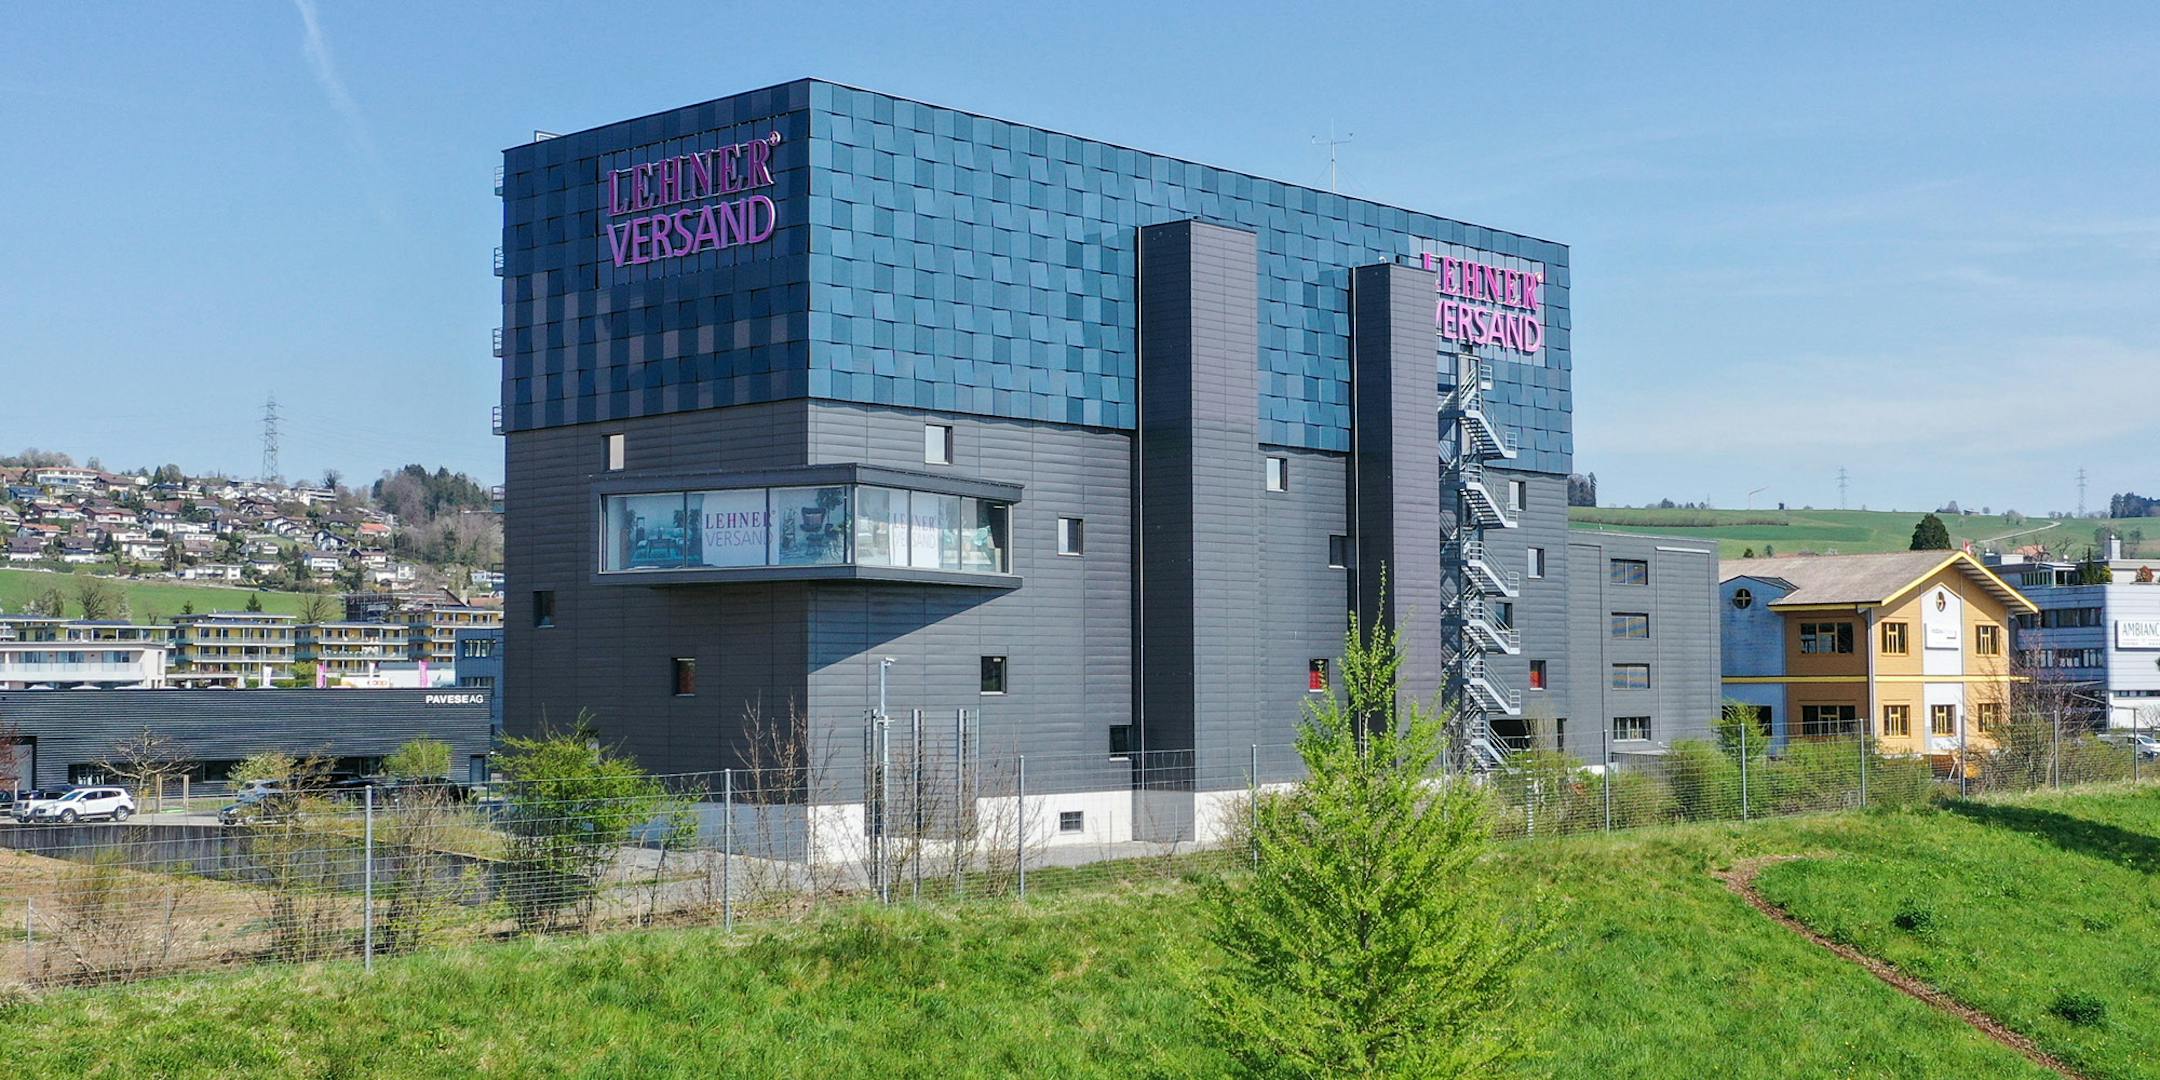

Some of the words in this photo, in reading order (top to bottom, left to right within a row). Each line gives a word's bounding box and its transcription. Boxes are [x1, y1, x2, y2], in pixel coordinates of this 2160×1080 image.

[608, 139, 775, 216] LEHNER
[607, 195, 776, 267] VERSAND
[893, 512, 936, 532] LENER
[425, 694, 469, 704] PAVESE
[470, 694, 484, 704] AG
